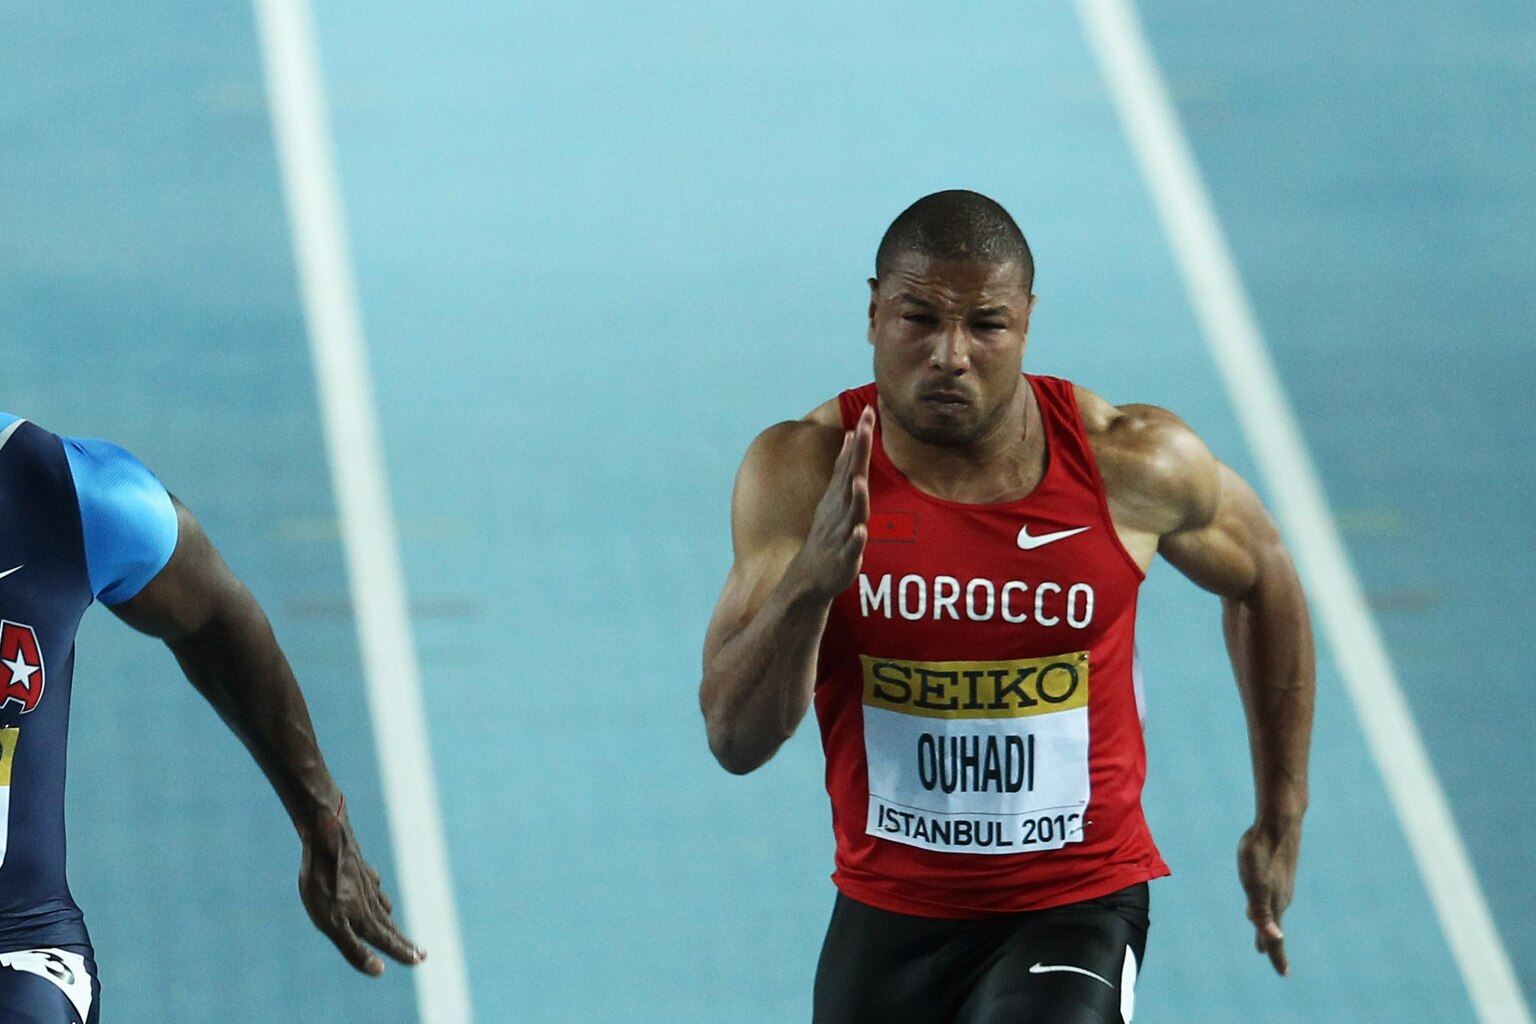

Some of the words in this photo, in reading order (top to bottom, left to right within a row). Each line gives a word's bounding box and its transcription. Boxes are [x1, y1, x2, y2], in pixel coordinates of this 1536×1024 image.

[858, 573, 1095, 629] MOROCCO
[871, 662, 1079, 711] SEIKO
[917, 733, 1035, 794] OUHADI
[878, 805, 1013, 847] ISTANBUL
